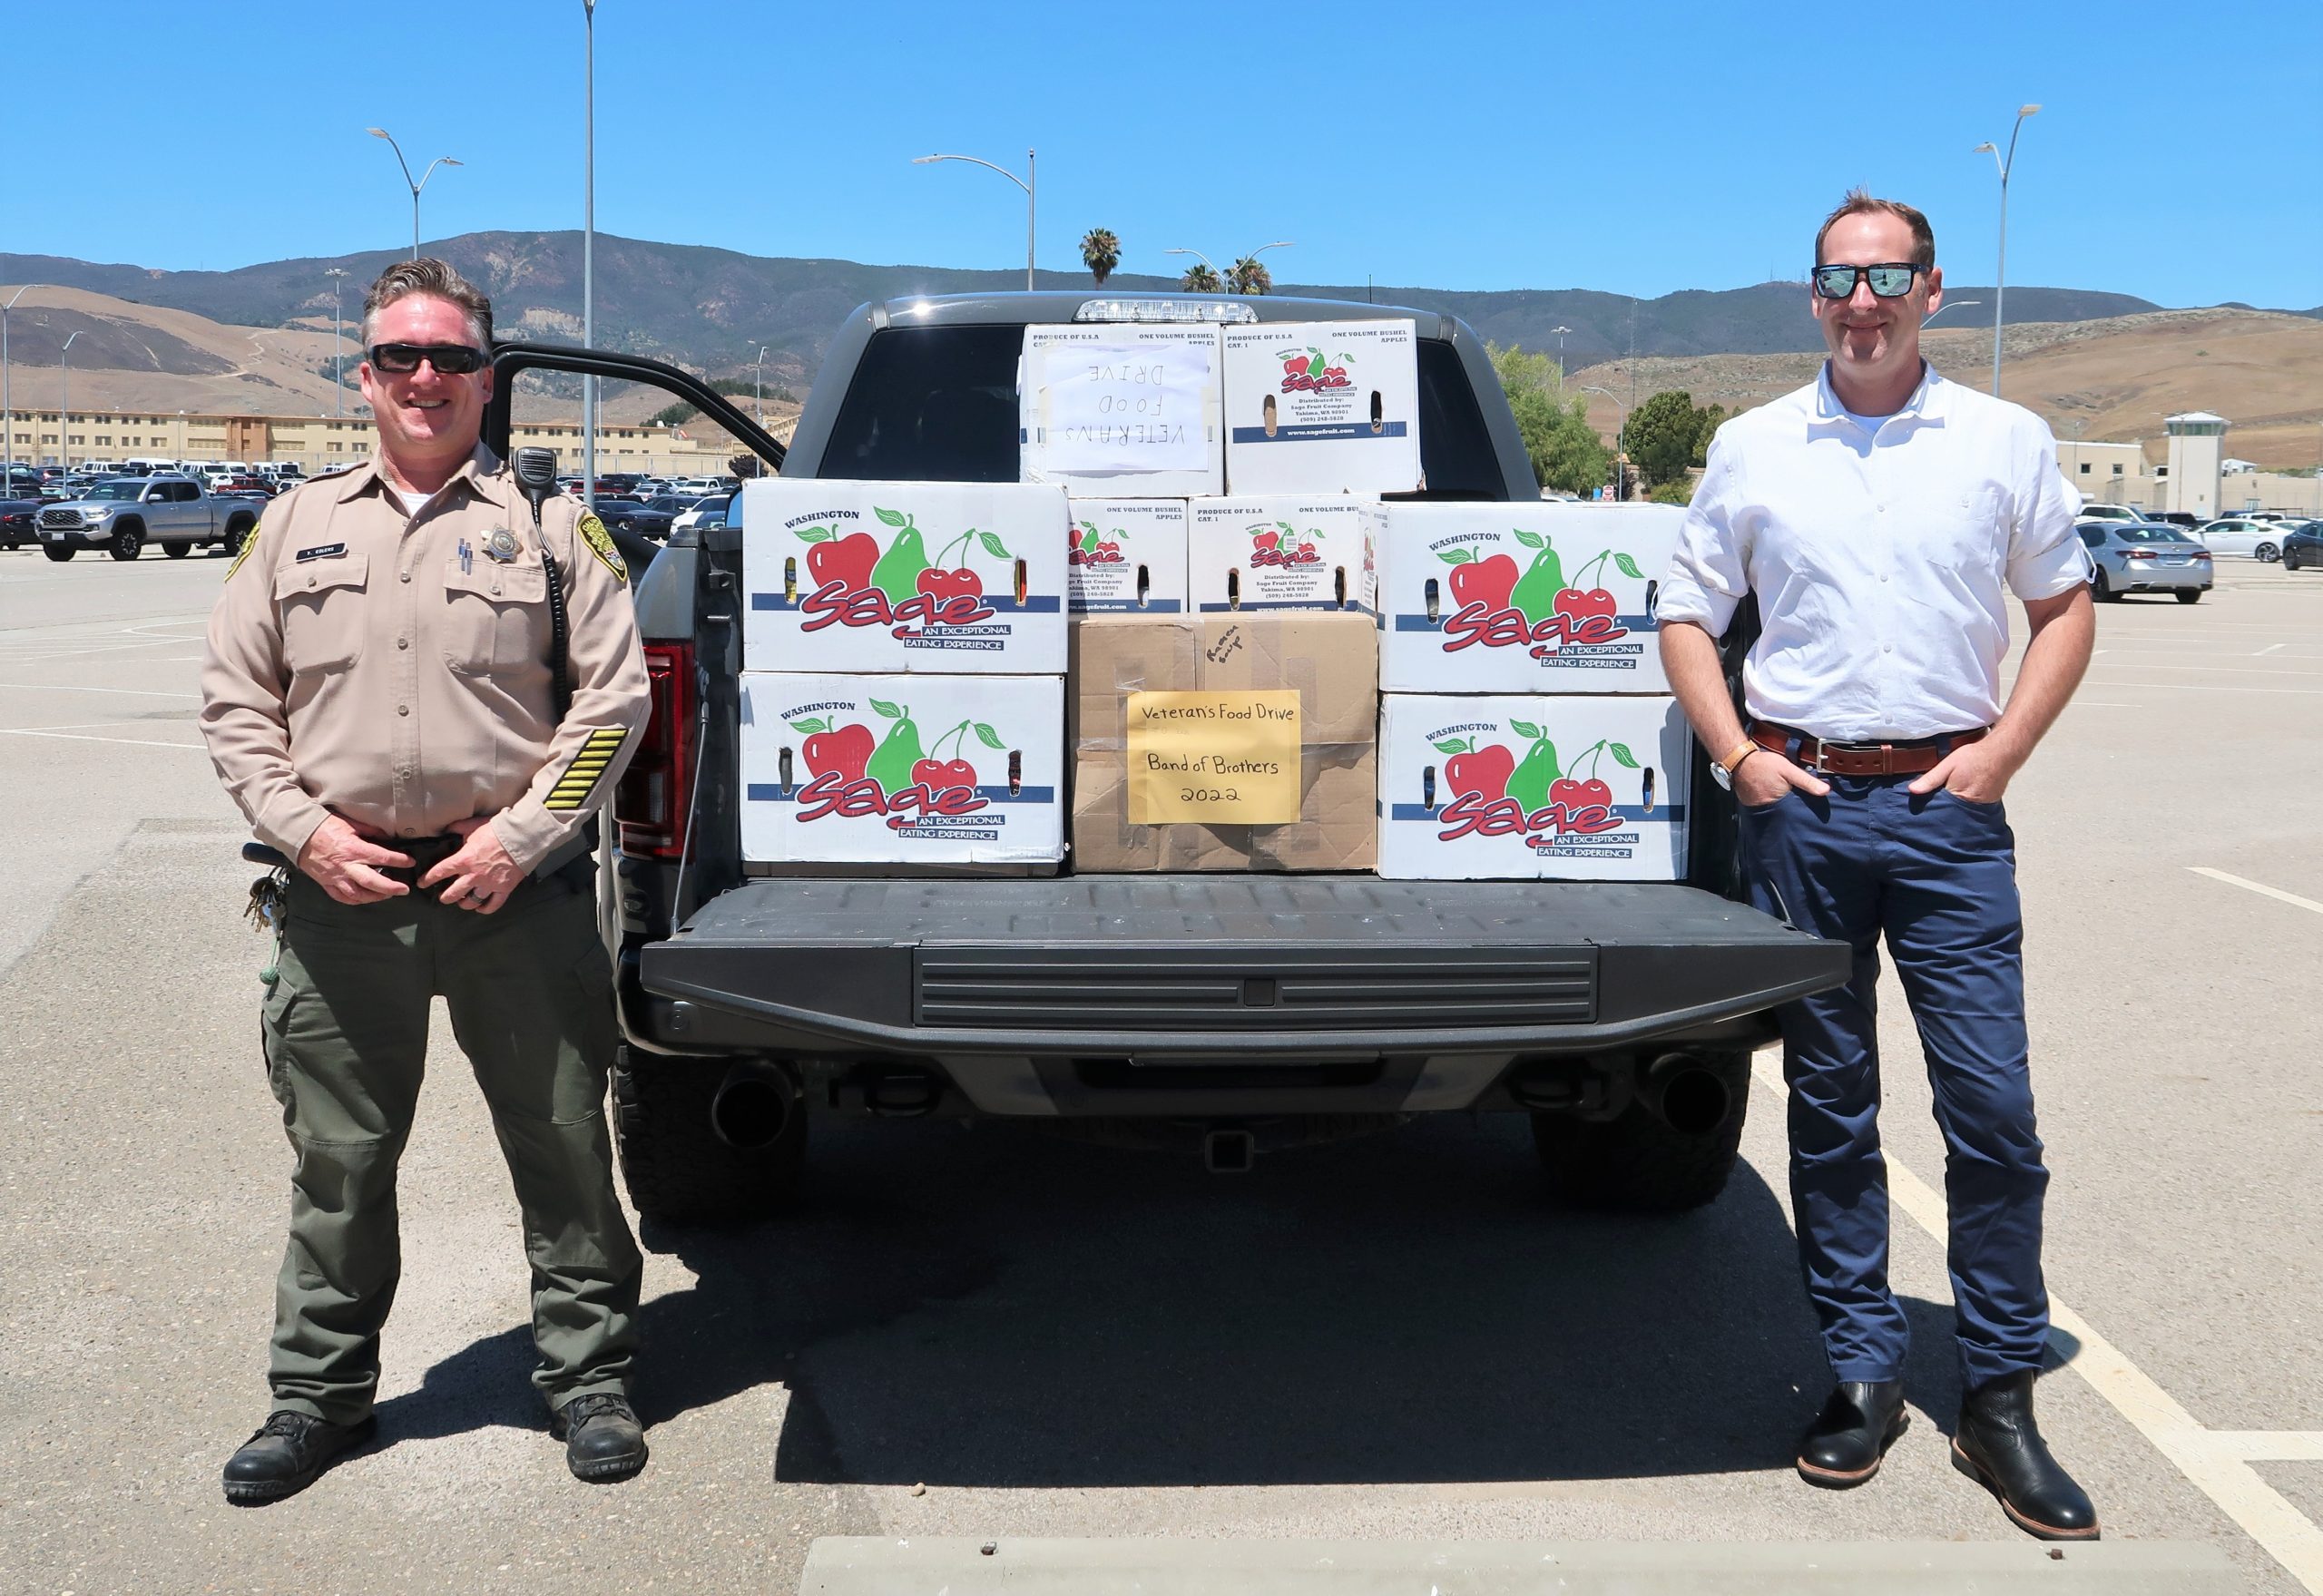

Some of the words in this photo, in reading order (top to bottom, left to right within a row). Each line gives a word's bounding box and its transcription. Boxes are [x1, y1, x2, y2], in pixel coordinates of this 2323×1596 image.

[1088, 365, 1164, 386] DRIVE
[1099, 395, 1162, 416] FOOD
[1065, 425, 1184, 446] VETERANS
[1287, 427, 1356, 437] www.sagefruit.com
[784, 509, 860, 530] WASHINGTON
[1428, 532, 1502, 553] WASHINGTON
[924, 627, 938, 635] AN
[941, 625, 1010, 635] EXCEPTIONAL
[906, 639, 941, 649] EATING
[944, 640, 1002, 650] EXPERIENCE
[1560, 646, 1574, 654] AN
[1577, 644, 1642, 654] EXCEPTIONAL
[1543, 658, 1577, 668] EATING
[1579, 659, 1634, 669] EXPERIENCE
[779, 701, 856, 720] WASHINGTON
[1142, 704, 1216, 720] Veteran's
[1219, 704, 1251, 720] Food
[1256, 703, 1294, 721] Drive
[1425, 722, 1498, 742] WASHINGTON
[1147, 753, 1188, 771] Band
[1192, 755, 1210, 772] of
[1212, 755, 1279, 775] Brothers
[1181, 788, 1241, 802] 2022
[918, 817, 934, 826] AN
[936, 816, 1004, 826] EXCEPTIONAL
[899, 828, 936, 838] EATING
[937, 829, 995, 840] EXPERIENCE
[1556, 836, 1571, 845] AN
[1573, 835, 1639, 845] EXCEPTIONAL
[1538, 847, 1573, 857] EATING
[1574, 848, 1631, 858] EXPERIENCE
